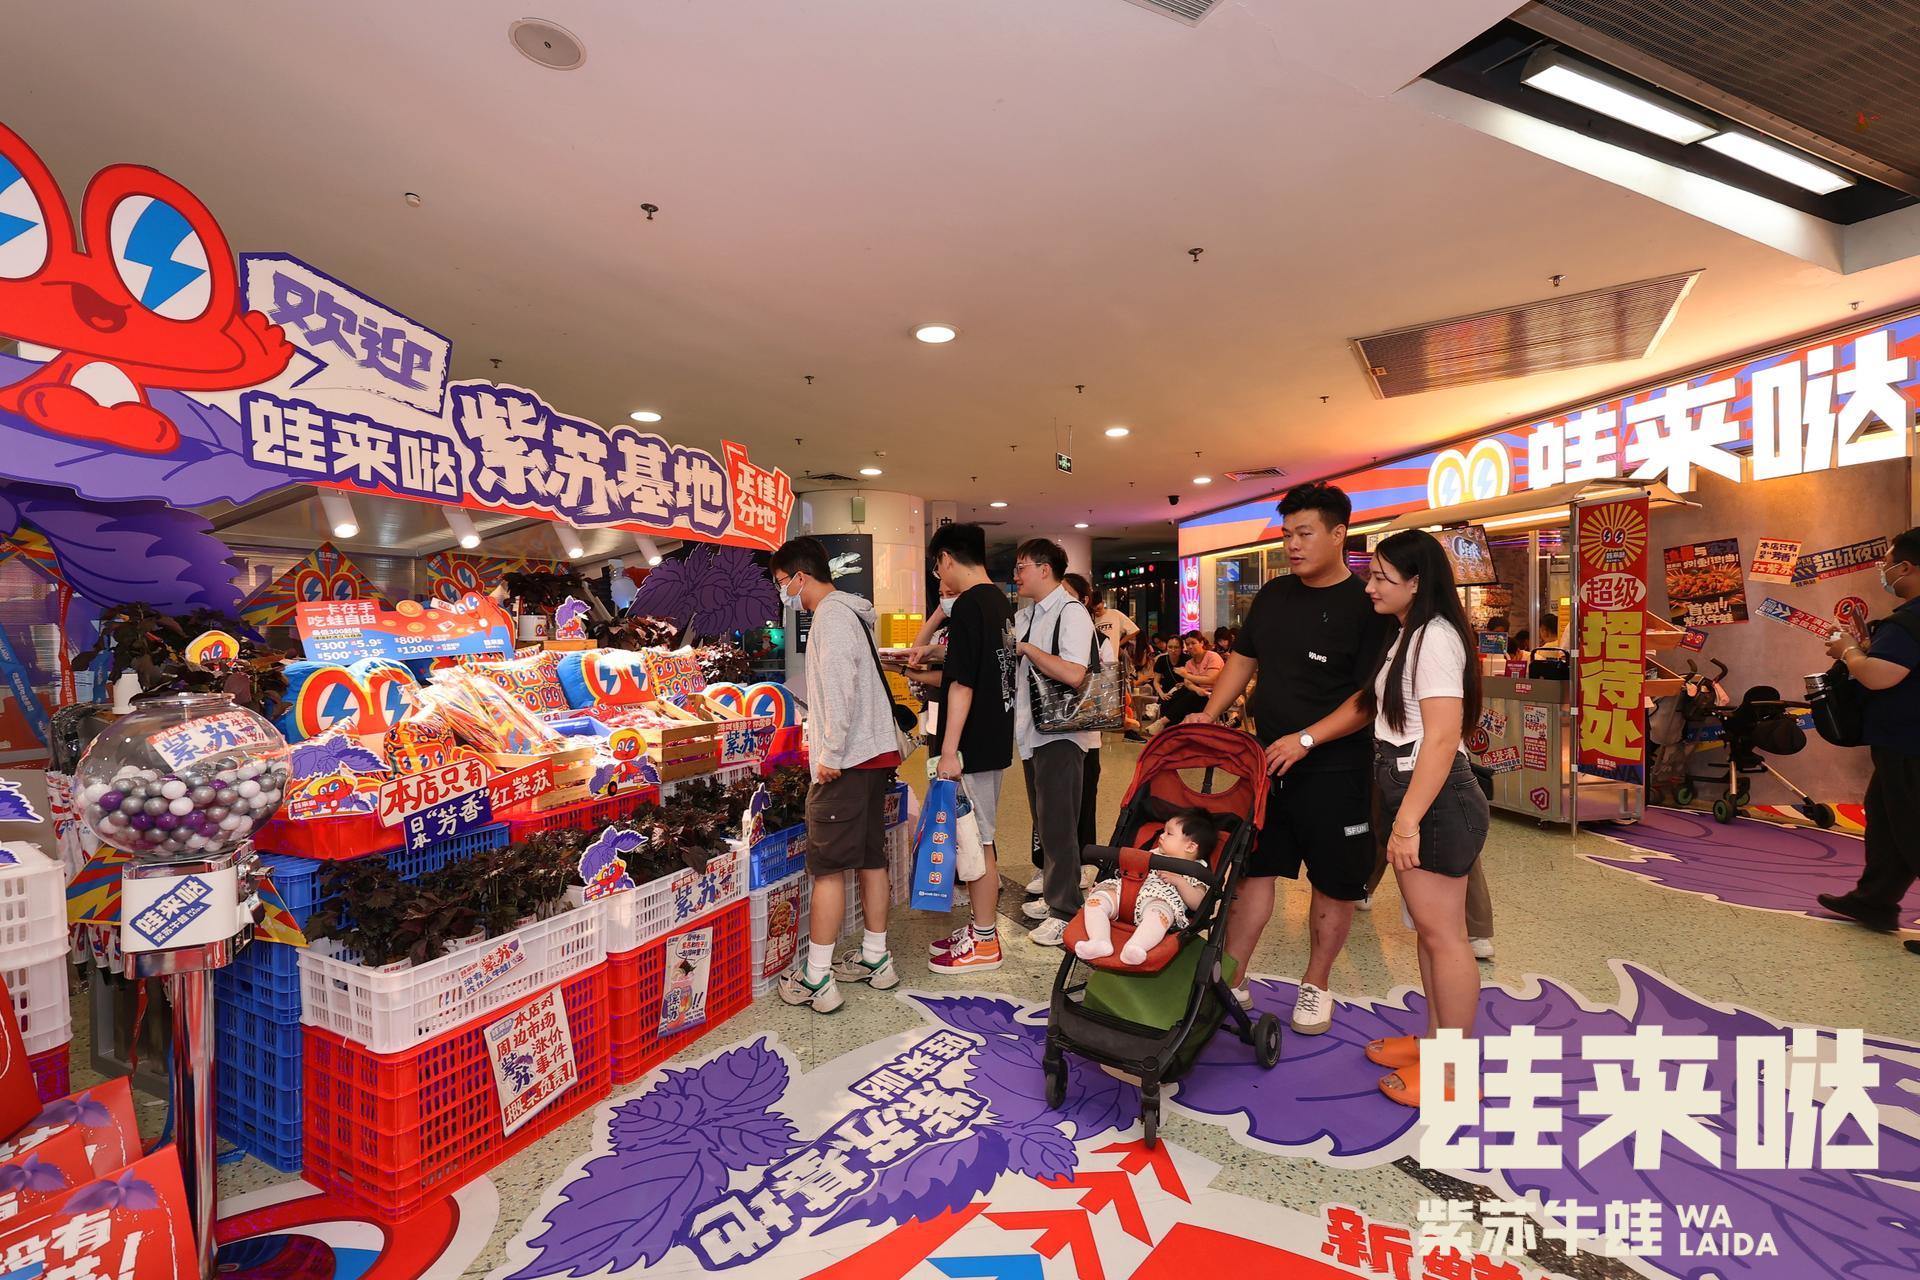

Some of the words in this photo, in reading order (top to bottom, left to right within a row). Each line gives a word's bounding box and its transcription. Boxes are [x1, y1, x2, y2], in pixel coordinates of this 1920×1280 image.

[267, 270, 432, 391] 欢迎
[1528, 330, 1909, 493] 蛙来哒
[249, 398, 459, 496] 蛙来哒
[459, 392, 727, 529] 紫苏基地
[736, 494, 778, 533] 分地
[303, 601, 375, 615] 一卡在手
[1585, 576, 1639, 608] 超级
[306, 614, 377, 627] 吃蛙自由
[1307, 650, 1328, 663] VANS
[1579, 610, 1645, 761] 招待处
[161, 721, 238, 768] 紫苏
[382, 761, 483, 817] 本店只有
[490, 768, 551, 811] 红紫苏
[135, 879, 208, 936] 蛙来哒
[674, 872, 719, 923] 紫苏
[513, 991, 555, 1030] 本店对
[496, 1010, 556, 1062] 周边市场
[532, 1026, 565, 1058] 涨价
[535, 1042, 569, 1075] 事件
[501, 1052, 534, 1094] 紫苏
